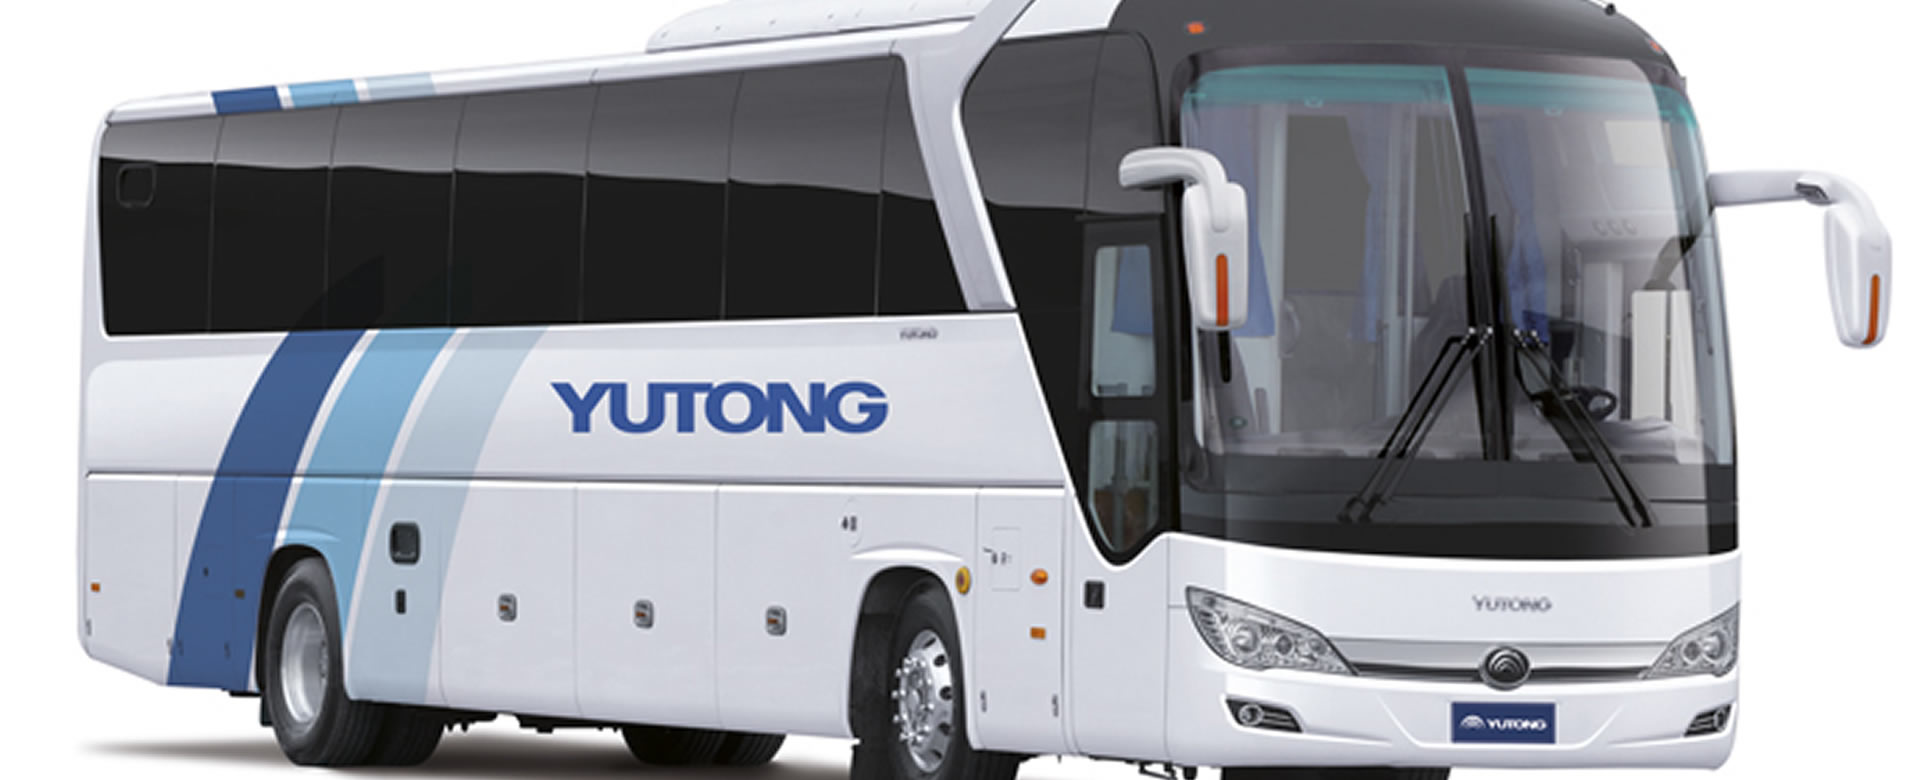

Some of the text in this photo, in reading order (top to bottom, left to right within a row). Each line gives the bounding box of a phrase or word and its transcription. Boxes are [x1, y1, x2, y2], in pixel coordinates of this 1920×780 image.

[550, 381, 889, 434] YUTONG
[1471, 595, 1553, 612] YUTONG
[1486, 719, 1547, 731] YUTONG
